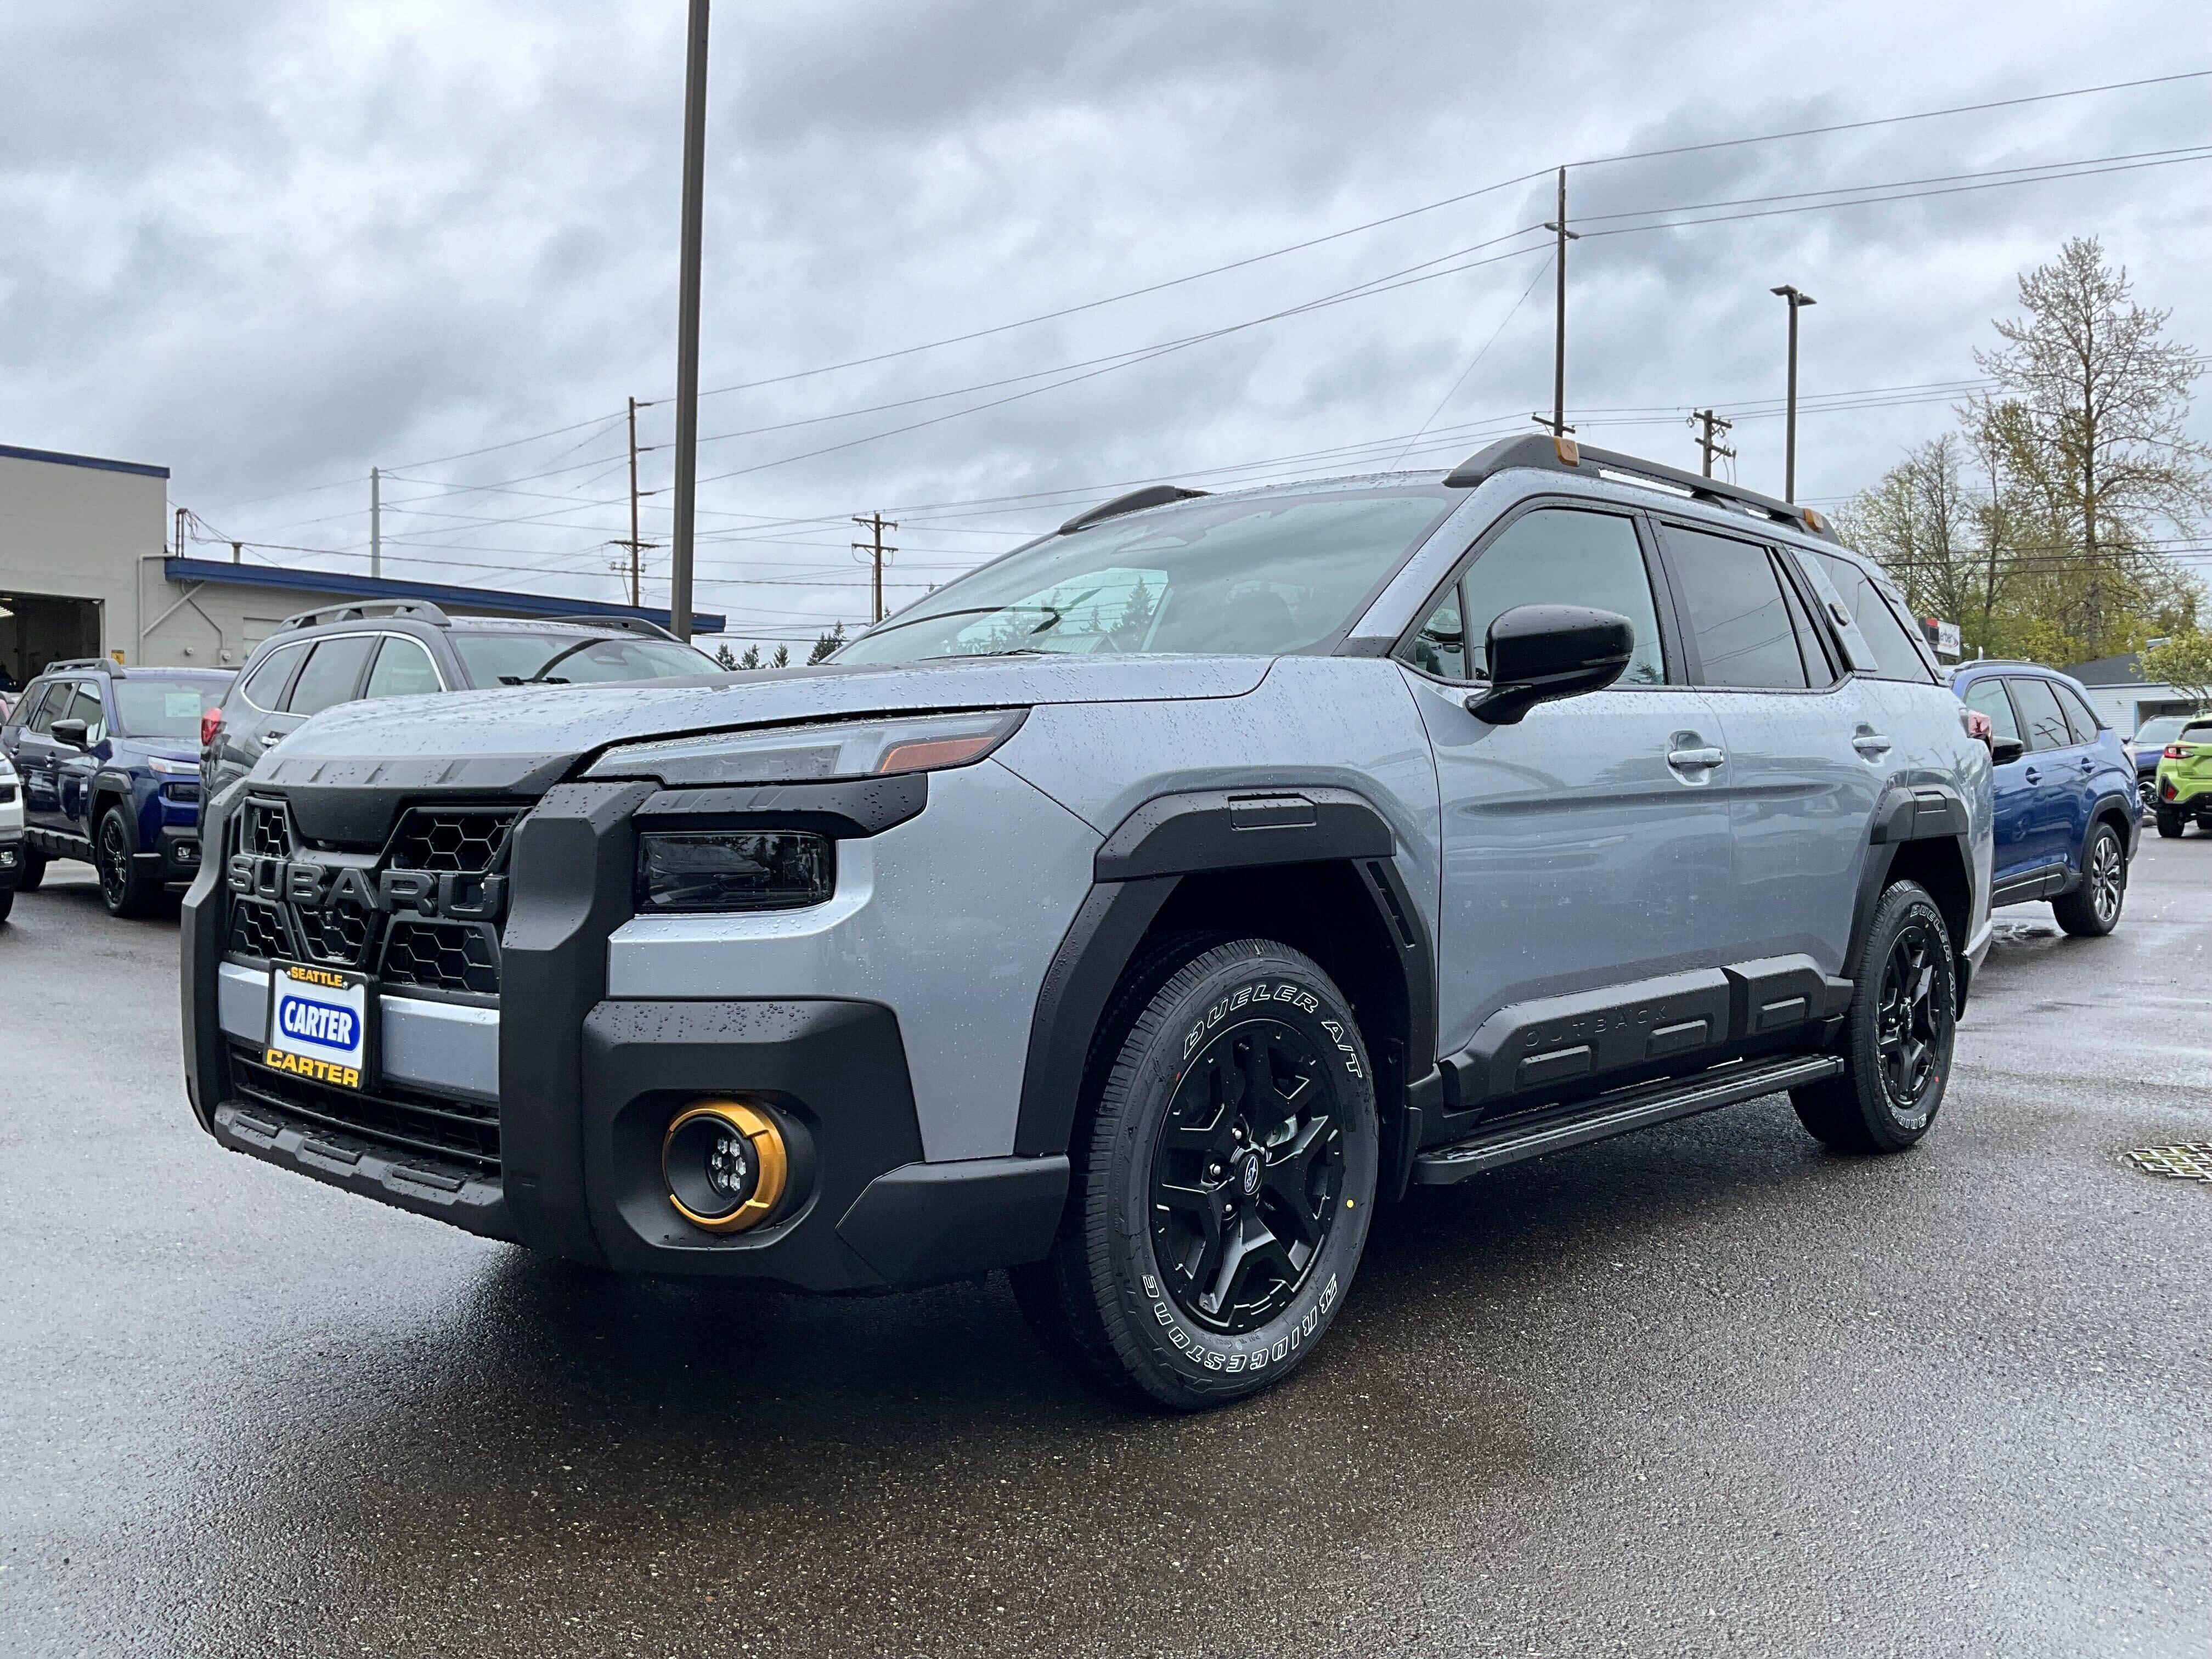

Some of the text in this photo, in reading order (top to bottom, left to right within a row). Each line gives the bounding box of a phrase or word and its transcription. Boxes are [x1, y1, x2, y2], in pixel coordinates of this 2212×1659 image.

[228, 854, 509, 921] SUBARU
[1910, 905, 1952, 962] DUELER
[290, 967, 343, 987] SEATTLE
[284, 1001, 352, 1045] CARTER
[1183, 985, 1318, 1060] DUELER
[1525, 1006, 1667, 1047] OUTBACK
[266, 1048, 359, 1088] CARTER
[1142, 1273, 1337, 1373] BRIDGESTONE
